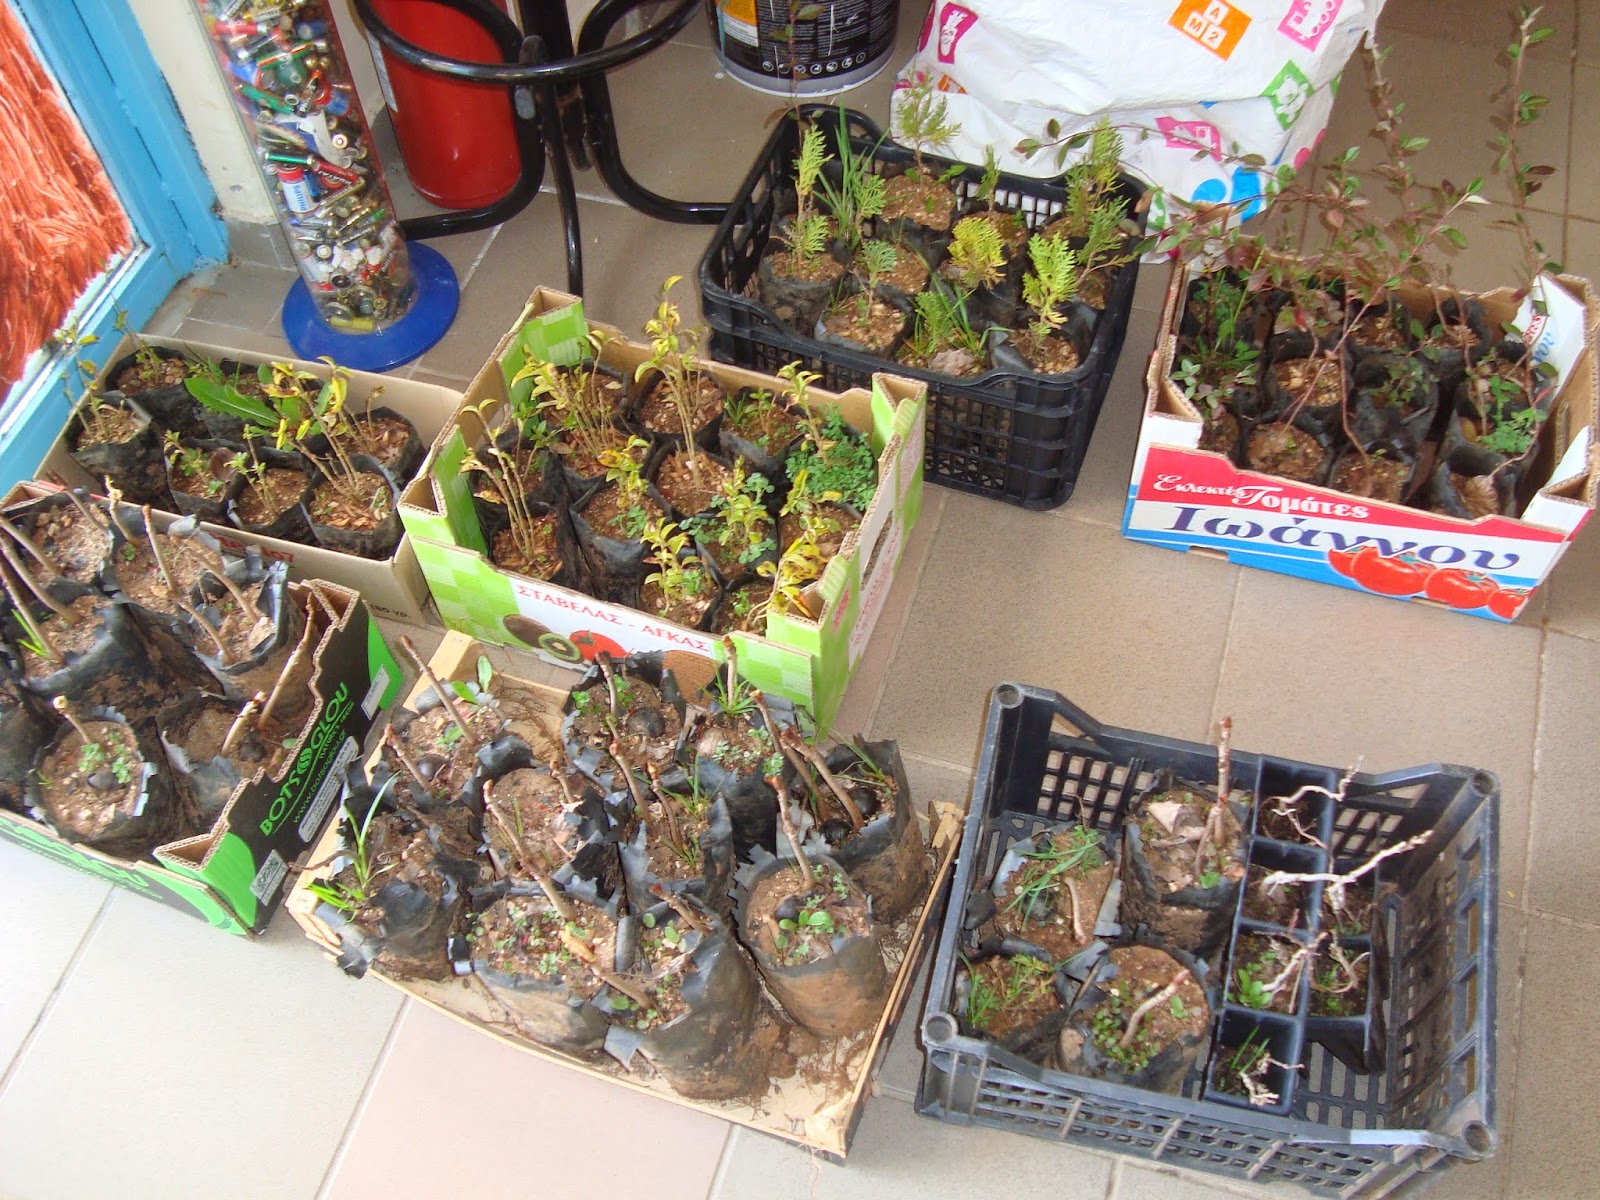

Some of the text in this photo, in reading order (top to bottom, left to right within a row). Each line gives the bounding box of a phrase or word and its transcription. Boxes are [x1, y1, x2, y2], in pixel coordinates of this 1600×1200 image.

[292, 185, 308, 212] PHILIPS
[1231, 485, 1369, 519] Τομάτες
[1164, 506, 1520, 570] Ιωάννου
[517, 584, 623, 626] ΣΤΑΒΕΛΑΣ
[641, 624, 710, 652] ΑΓΚΑΣ
